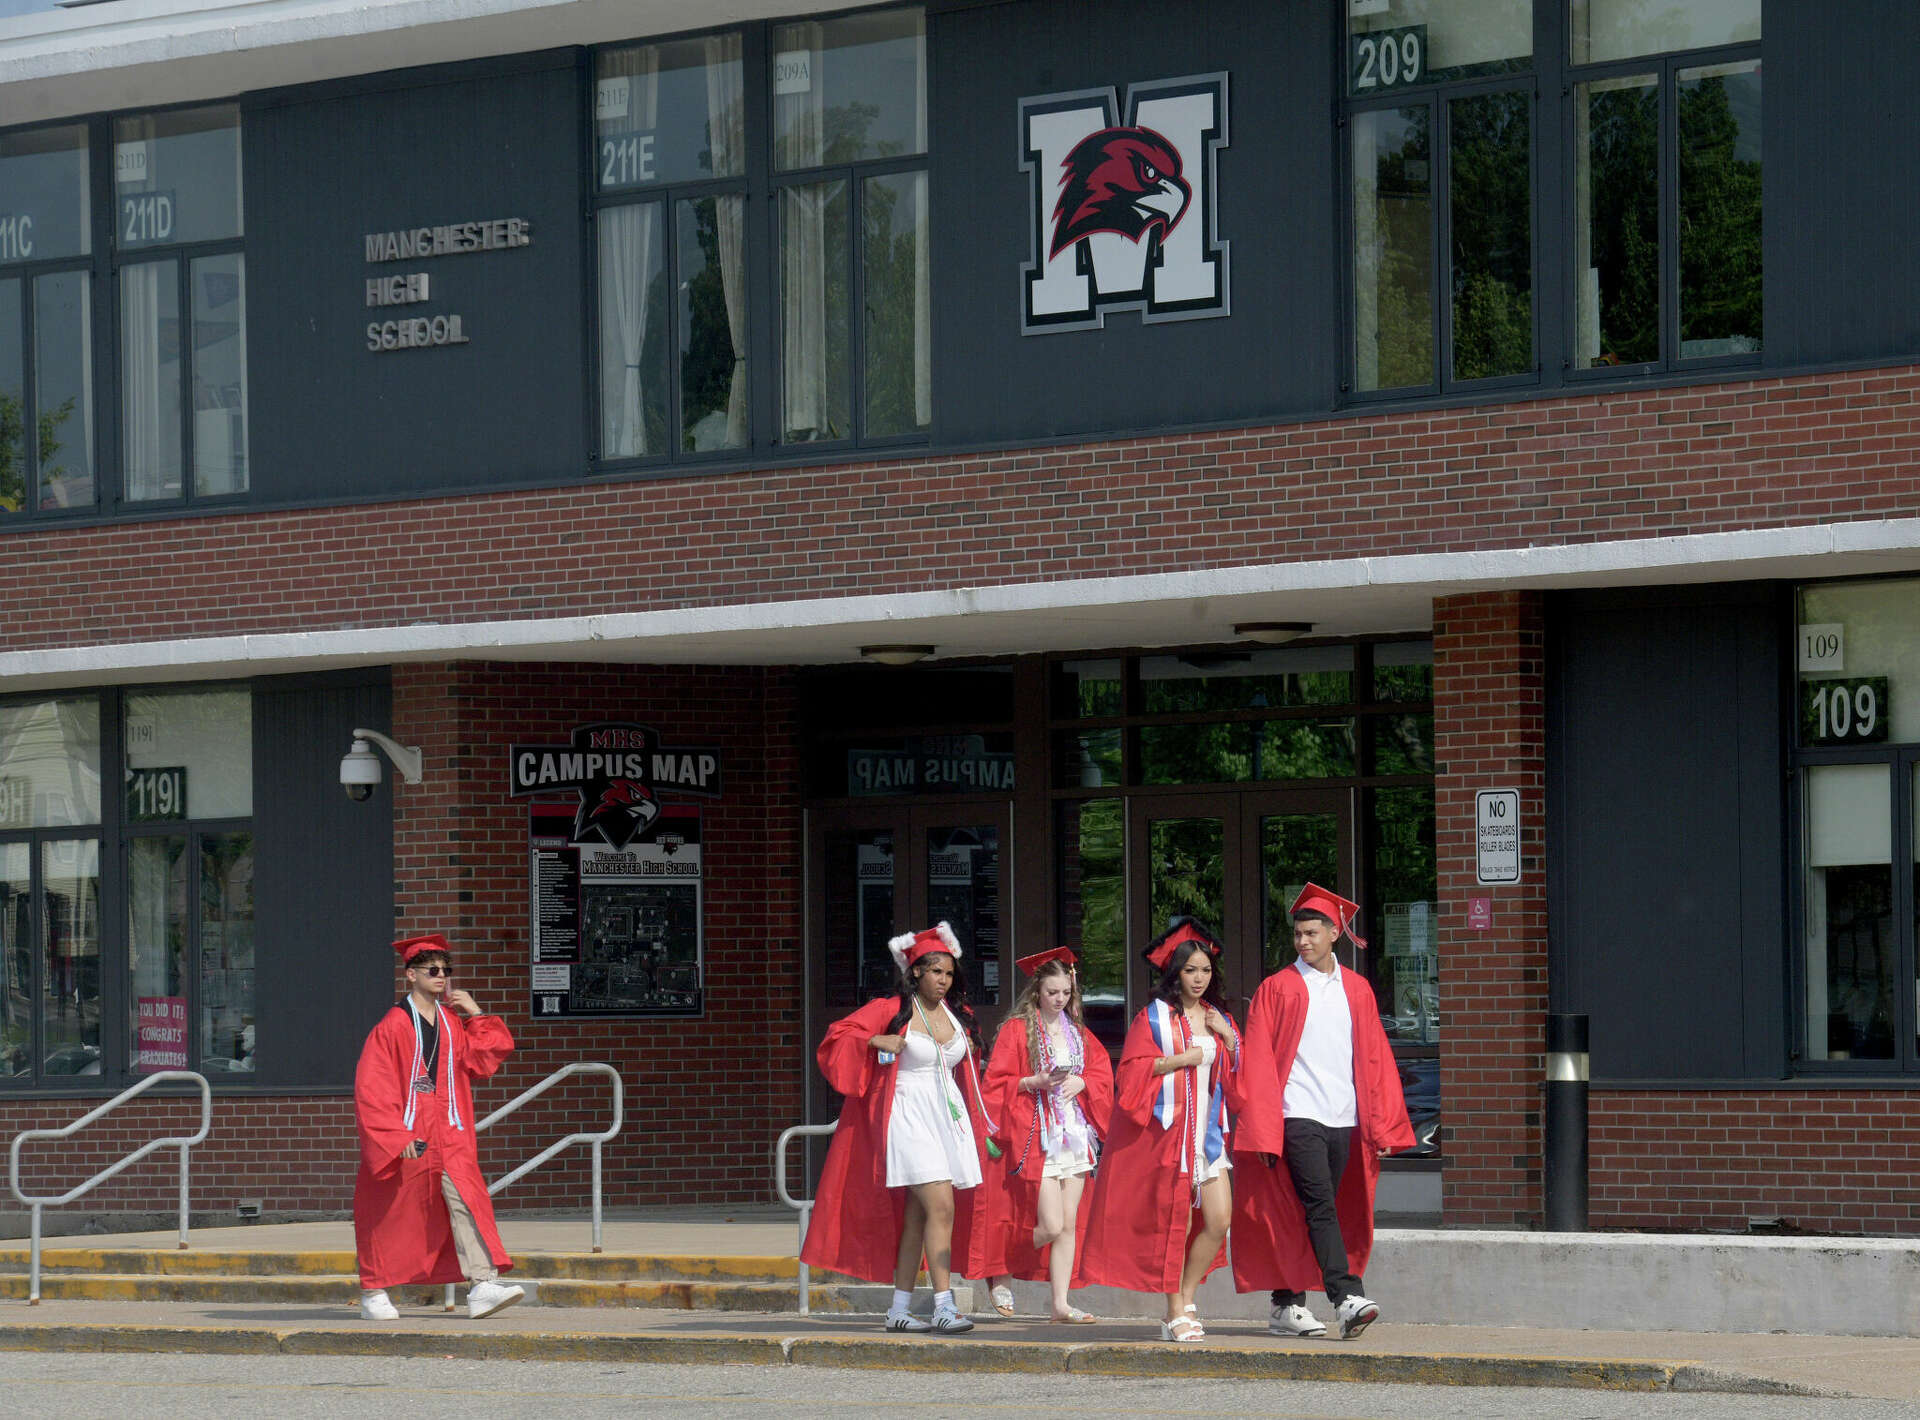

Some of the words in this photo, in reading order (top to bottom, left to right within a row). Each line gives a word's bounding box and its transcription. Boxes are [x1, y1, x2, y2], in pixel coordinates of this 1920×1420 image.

[1357, 33, 1420, 88] 209
[776, 64, 809, 82] 209A
[602, 136, 656, 186] 211E
[125, 196, 172, 241] 211D
[366, 217, 530, 263] MANCHESTER
[366, 272, 430, 307] HIGH
[367, 314, 470, 352] SCHOOL
[1807, 634, 1839, 659] 109
[1812, 685, 1876, 738] 109
[590, 729, 646, 749] MHS
[518, 752, 644, 787] CAMPUS
[652, 754, 716, 787] MAP
[1489, 801, 1506, 818] NO
[1480, 824, 1516, 837] SKATEBOARDS
[1480, 841, 1497, 852] ROLLER
[1498, 840, 1516, 852] BLADES
[582, 861, 641, 875] MANCHESTER
[642, 862, 665, 875] HIGH
[666, 862, 699, 875] SCHOOL
[140, 1003, 153, 1017] YOU
[155, 1003, 169, 1017] DID
[172, 1005, 184, 1020] IT!
[142, 1027, 182, 1043] CONGRATS
[140, 1050, 187, 1067] GRADUATES!
